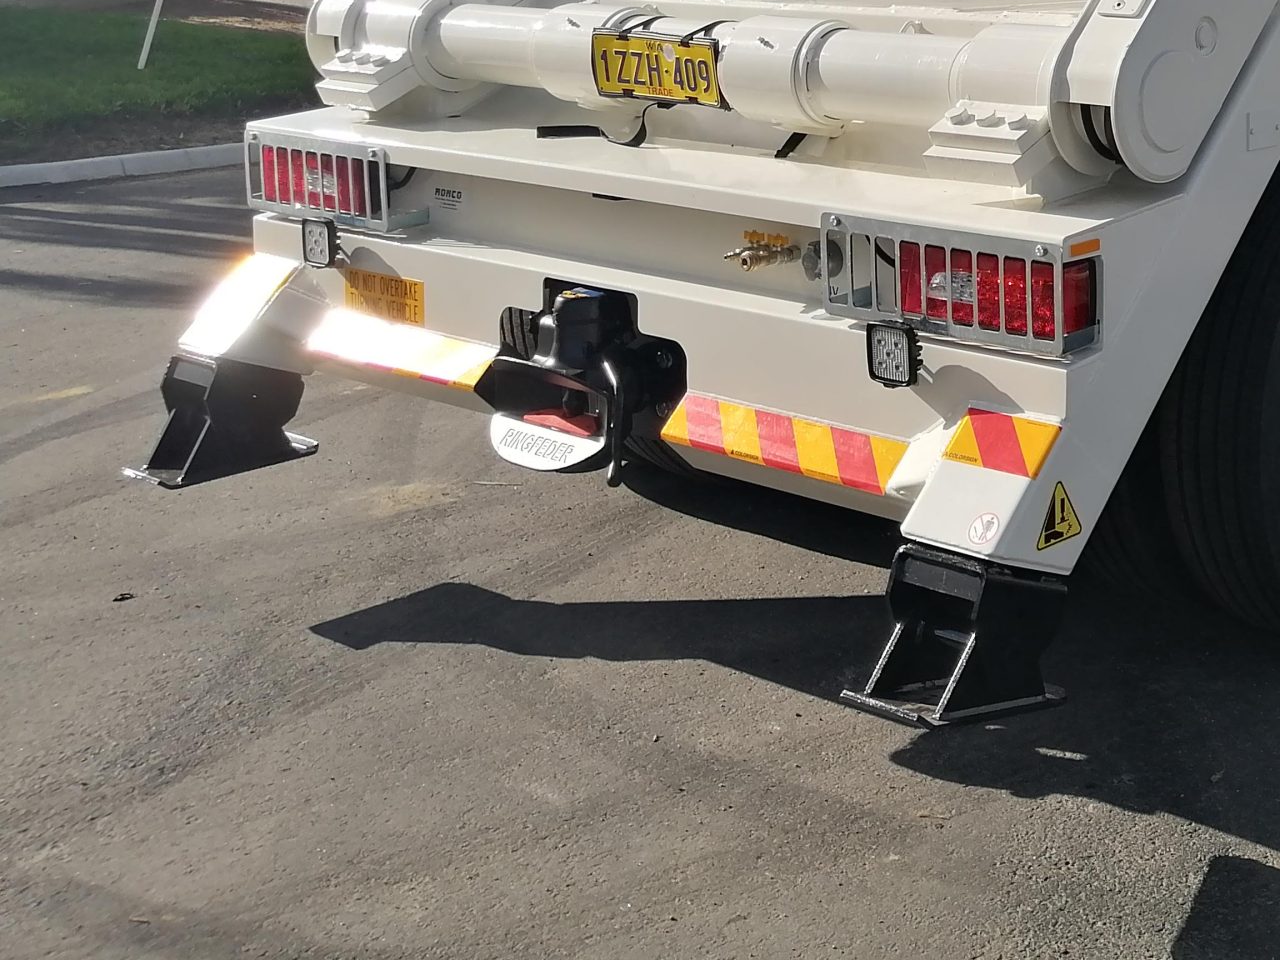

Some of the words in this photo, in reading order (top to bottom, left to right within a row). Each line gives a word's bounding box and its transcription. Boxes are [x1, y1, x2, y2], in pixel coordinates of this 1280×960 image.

[646, 86, 674, 97] TRADE
[349, 270, 360, 290] DO
[362, 273, 377, 293] NOT
[380, 275, 419, 302] OVERTAKE
[385, 300, 420, 324] VEHICLE
[499, 428, 575, 464] RINGFEDER
